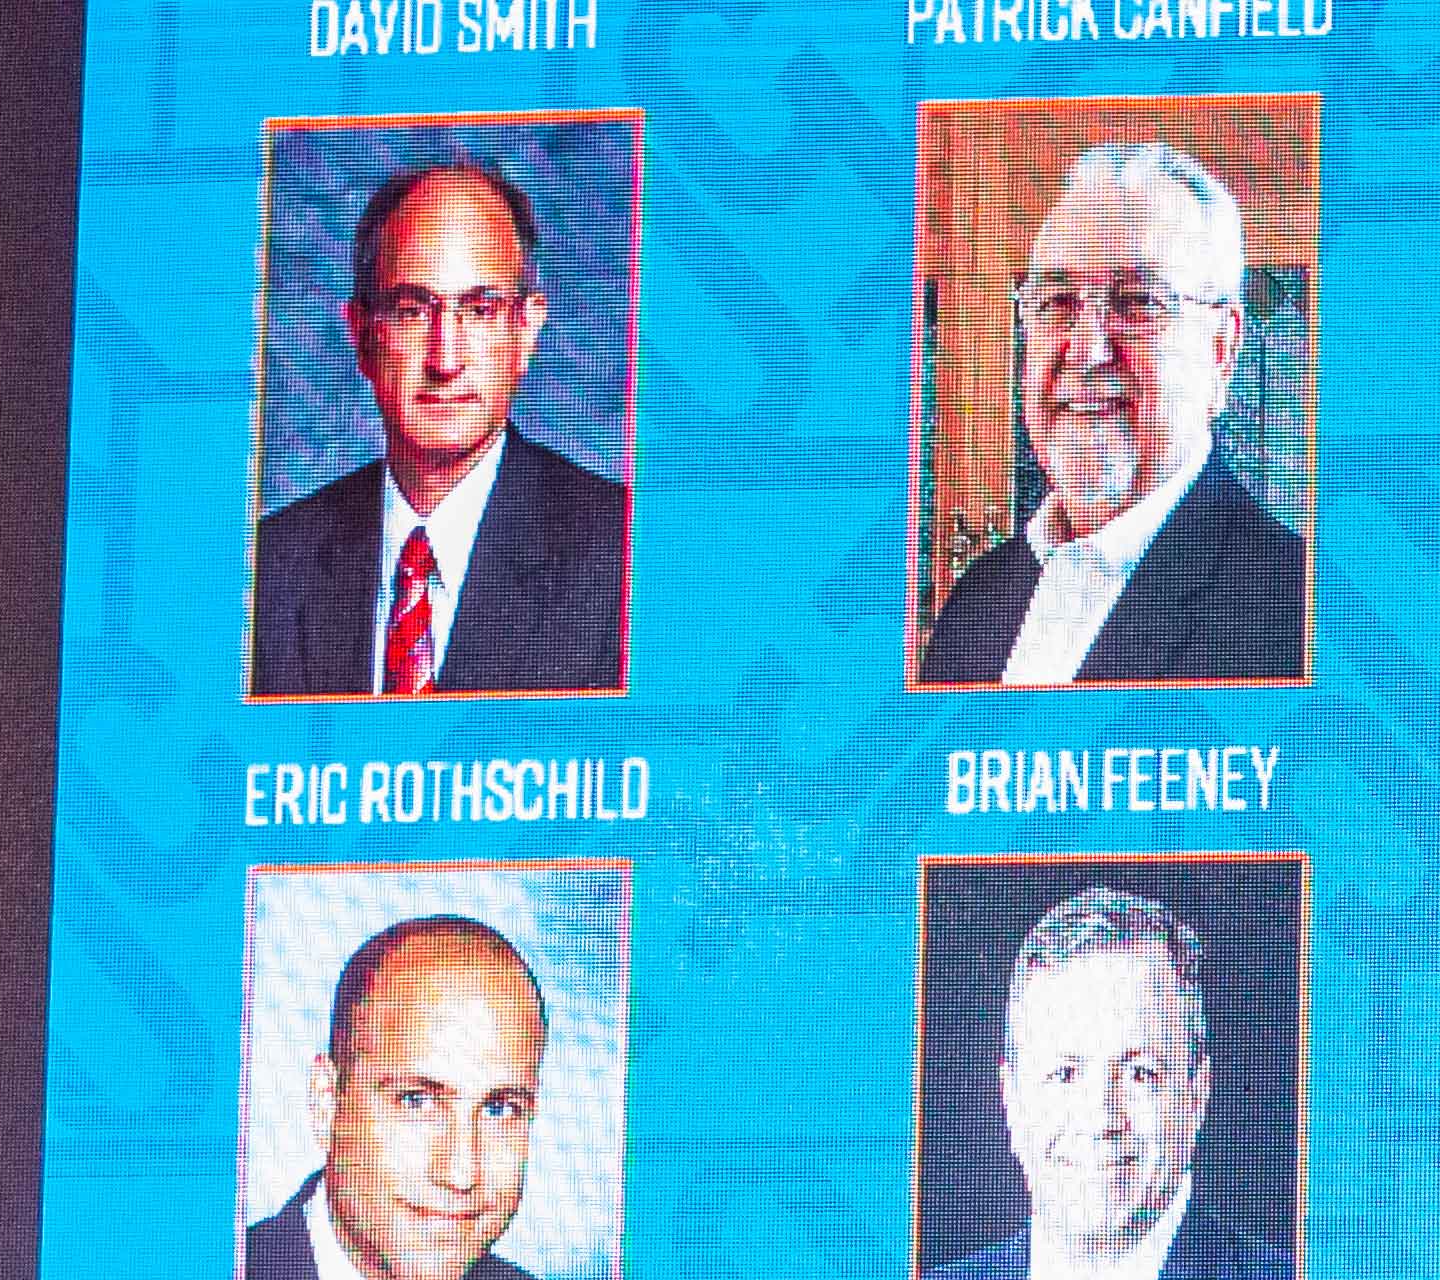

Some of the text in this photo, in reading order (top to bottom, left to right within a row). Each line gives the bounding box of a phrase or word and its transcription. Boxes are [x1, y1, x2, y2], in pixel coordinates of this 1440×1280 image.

[309, 0, 598, 57] DAVID SMITH
[906, 0, 1334, 44] PATRICK CANFIELD
[245, 757, 650, 826] ERIC ROTHSCHILD
[948, 745, 1279, 815] BRIAN FEENEY
